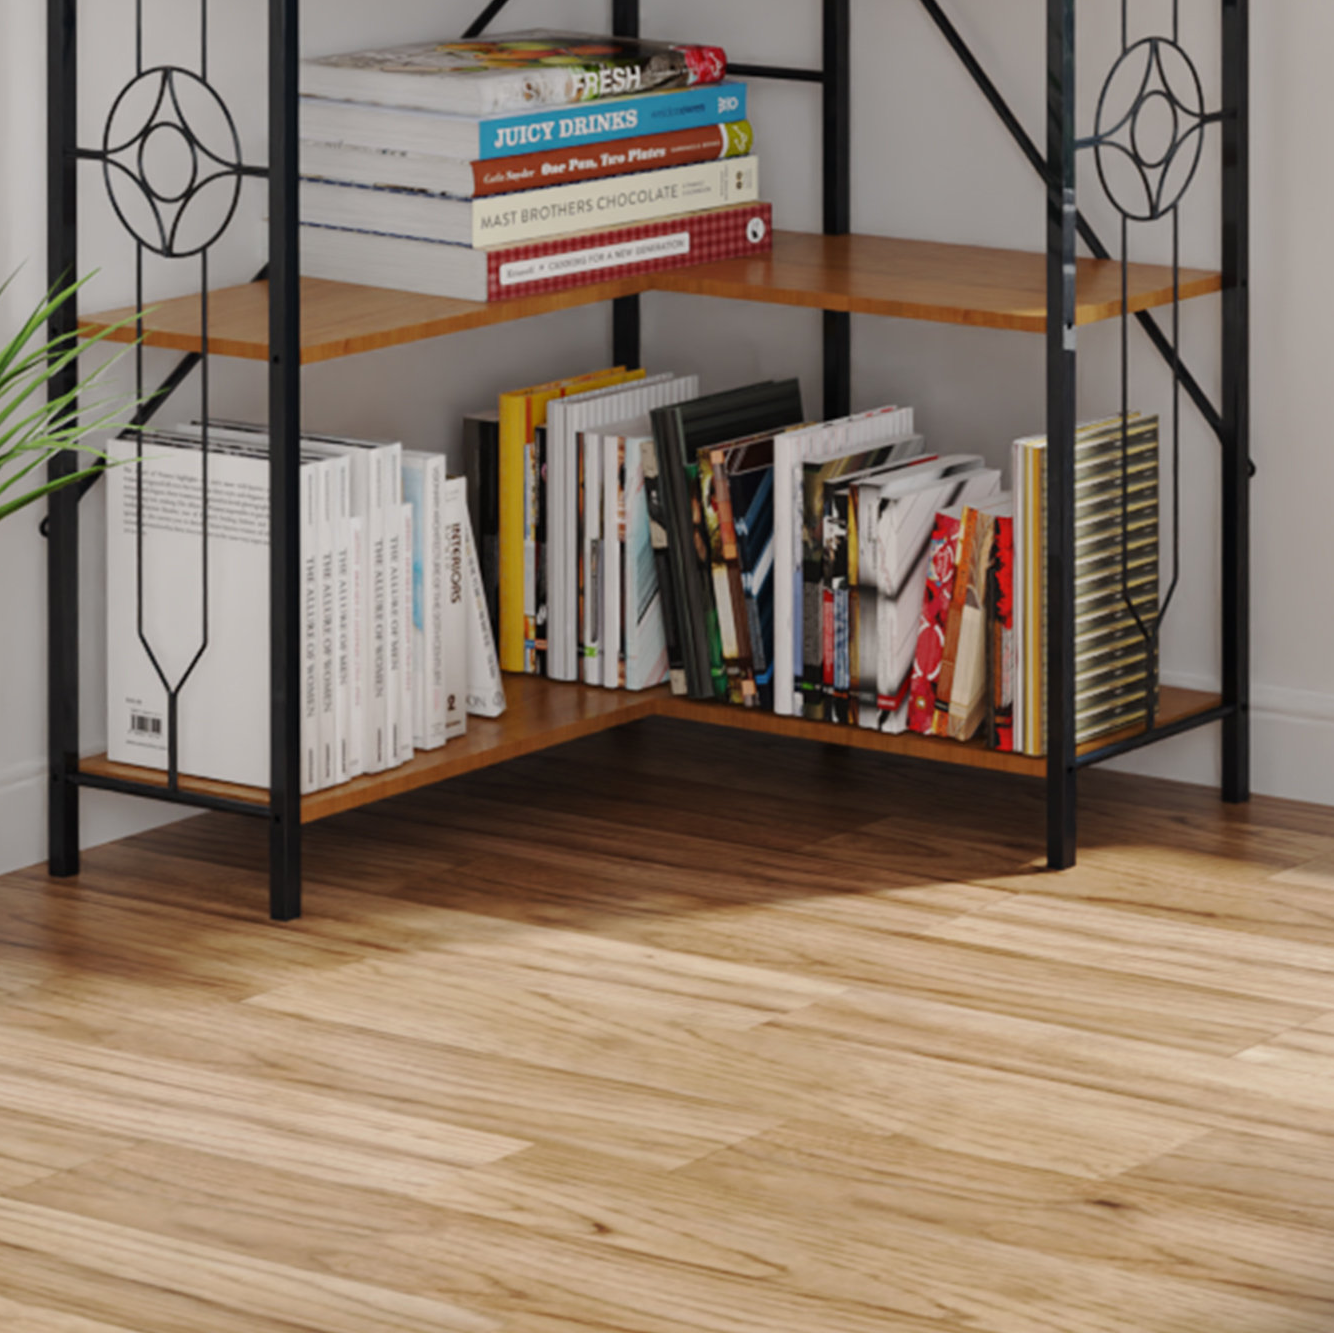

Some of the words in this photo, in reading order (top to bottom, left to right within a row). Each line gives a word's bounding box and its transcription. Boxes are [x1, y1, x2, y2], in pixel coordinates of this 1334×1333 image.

[571, 65, 641, 97] FRESH
[494, 122, 555, 149] JUICY
[559, 109, 638, 138] DRINKS
[541, 162, 566, 176] One
[568, 158, 598, 172] Pan,
[600, 152, 626, 167] Two
[627, 147, 667, 163] Plates
[480, 210, 518, 230] MAST
[521, 199, 595, 224] BROTHERS
[596, 184, 679, 210] CHOCOLATE
[588, 252, 606, 265] FOR
[615, 246, 633, 259] NEW
[635, 239, 685, 256] GENERATION
[450, 522, 462, 604] INTERIORS
